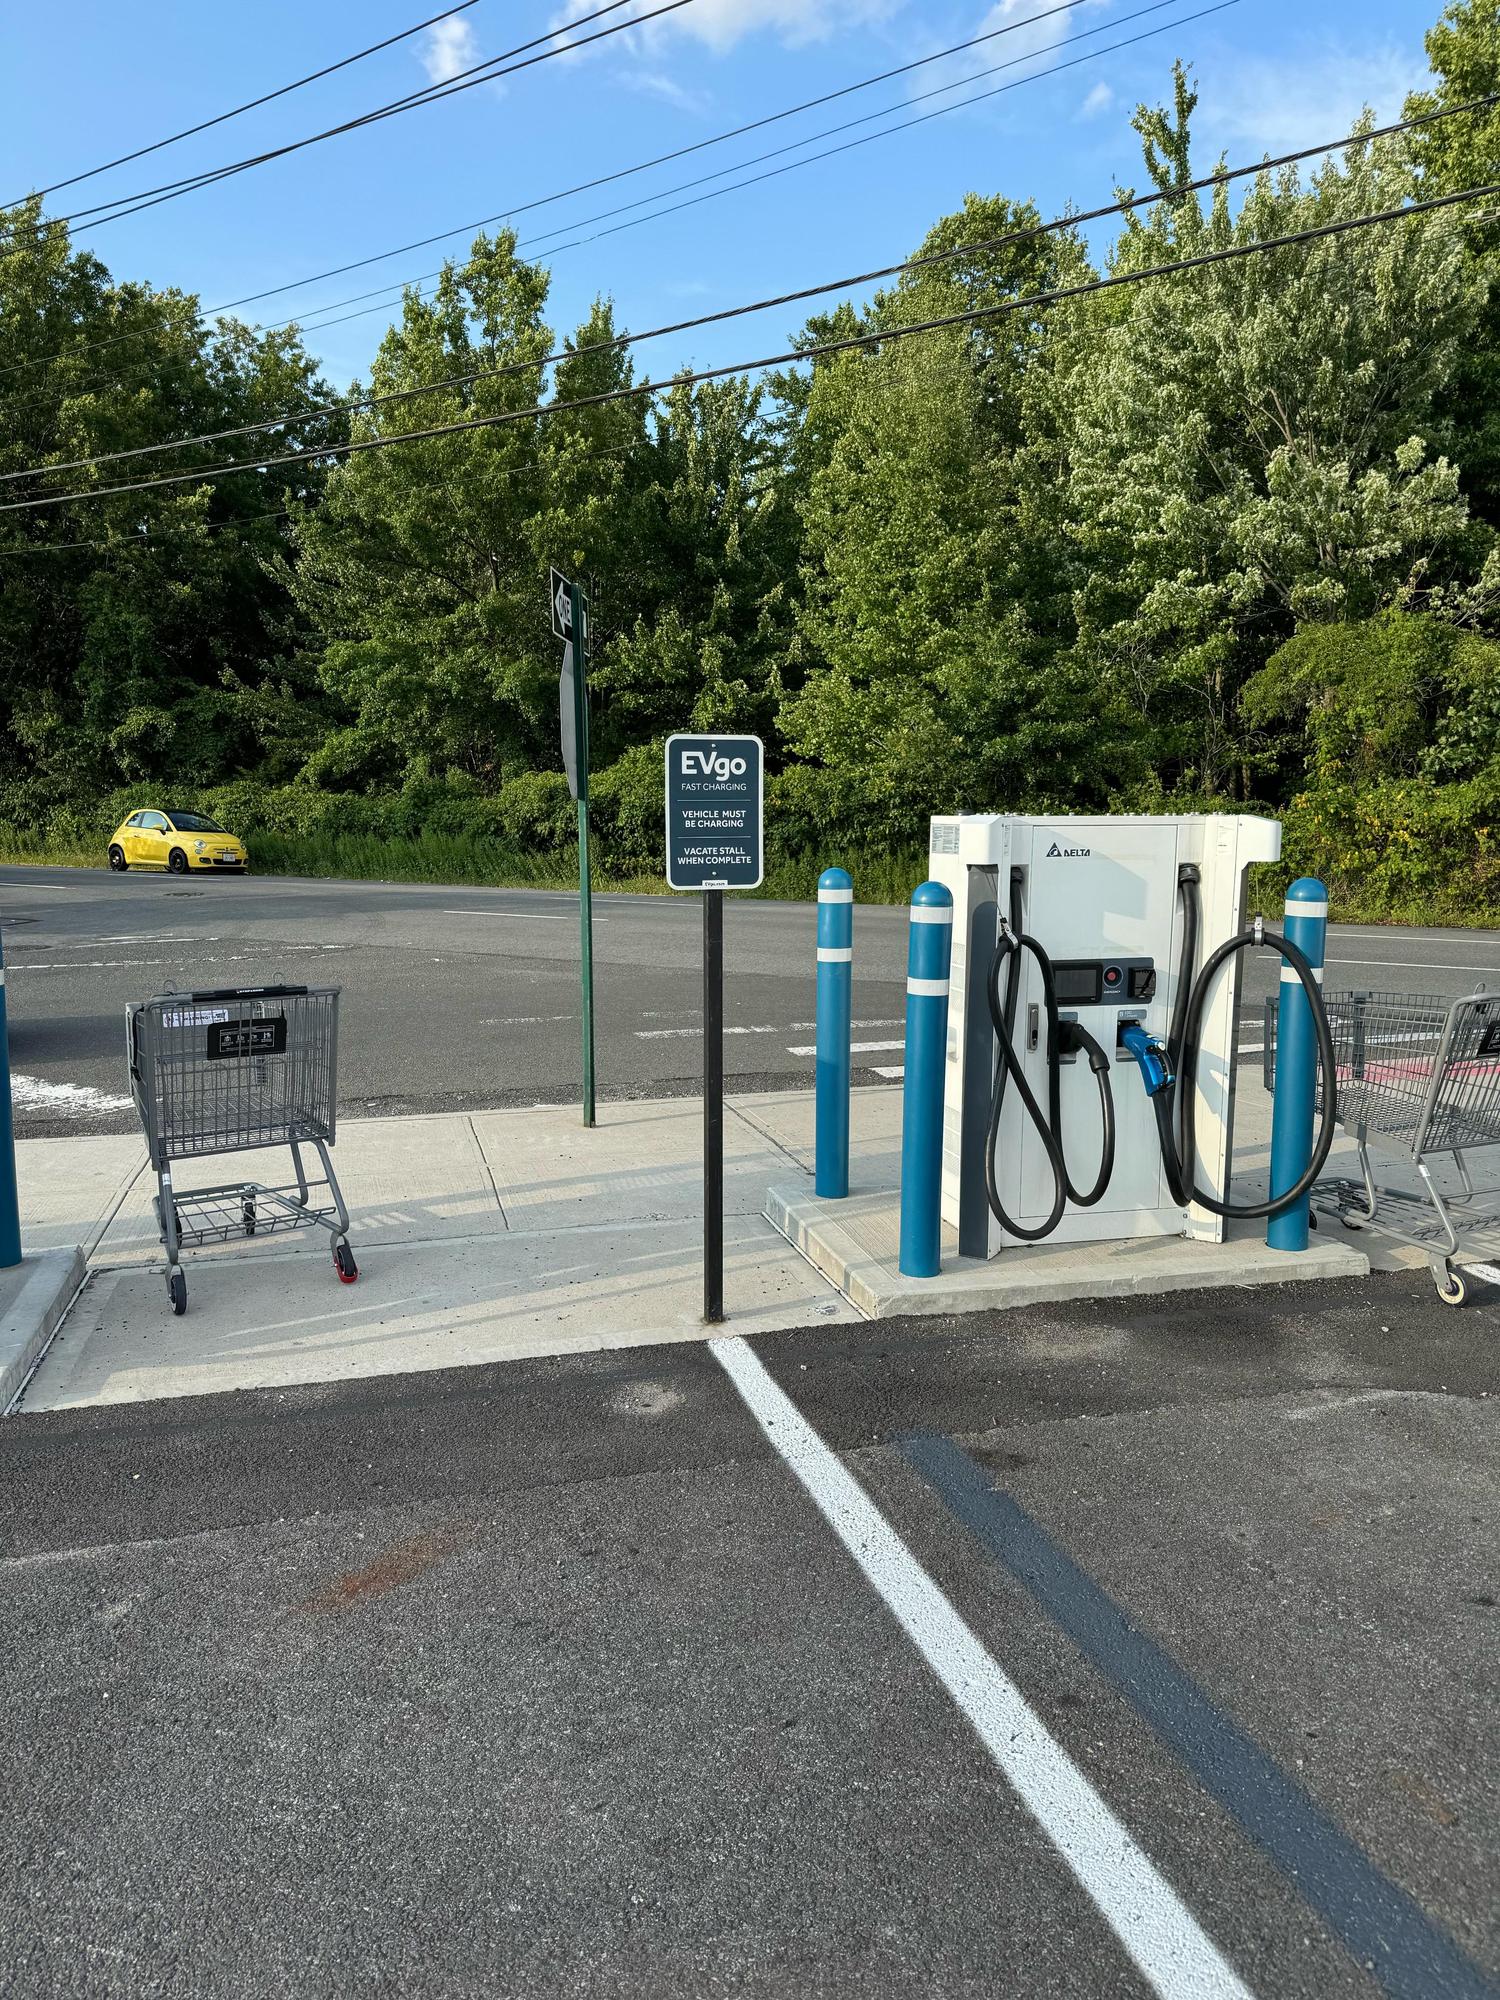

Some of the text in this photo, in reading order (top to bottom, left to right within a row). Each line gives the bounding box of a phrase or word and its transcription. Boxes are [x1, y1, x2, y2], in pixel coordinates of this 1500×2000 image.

[681, 751, 747, 781] EVgo
[681, 783, 747, 791] FAST CHARGING
[682, 810, 747, 818] VEHICLE MUST
[685, 820, 744, 828] BE CHARGING
[683, 847, 745, 855] VACATE STALL
[1064, 849, 1090, 857] DELTA
[677, 856, 752, 865] WHEN COMPLETE
